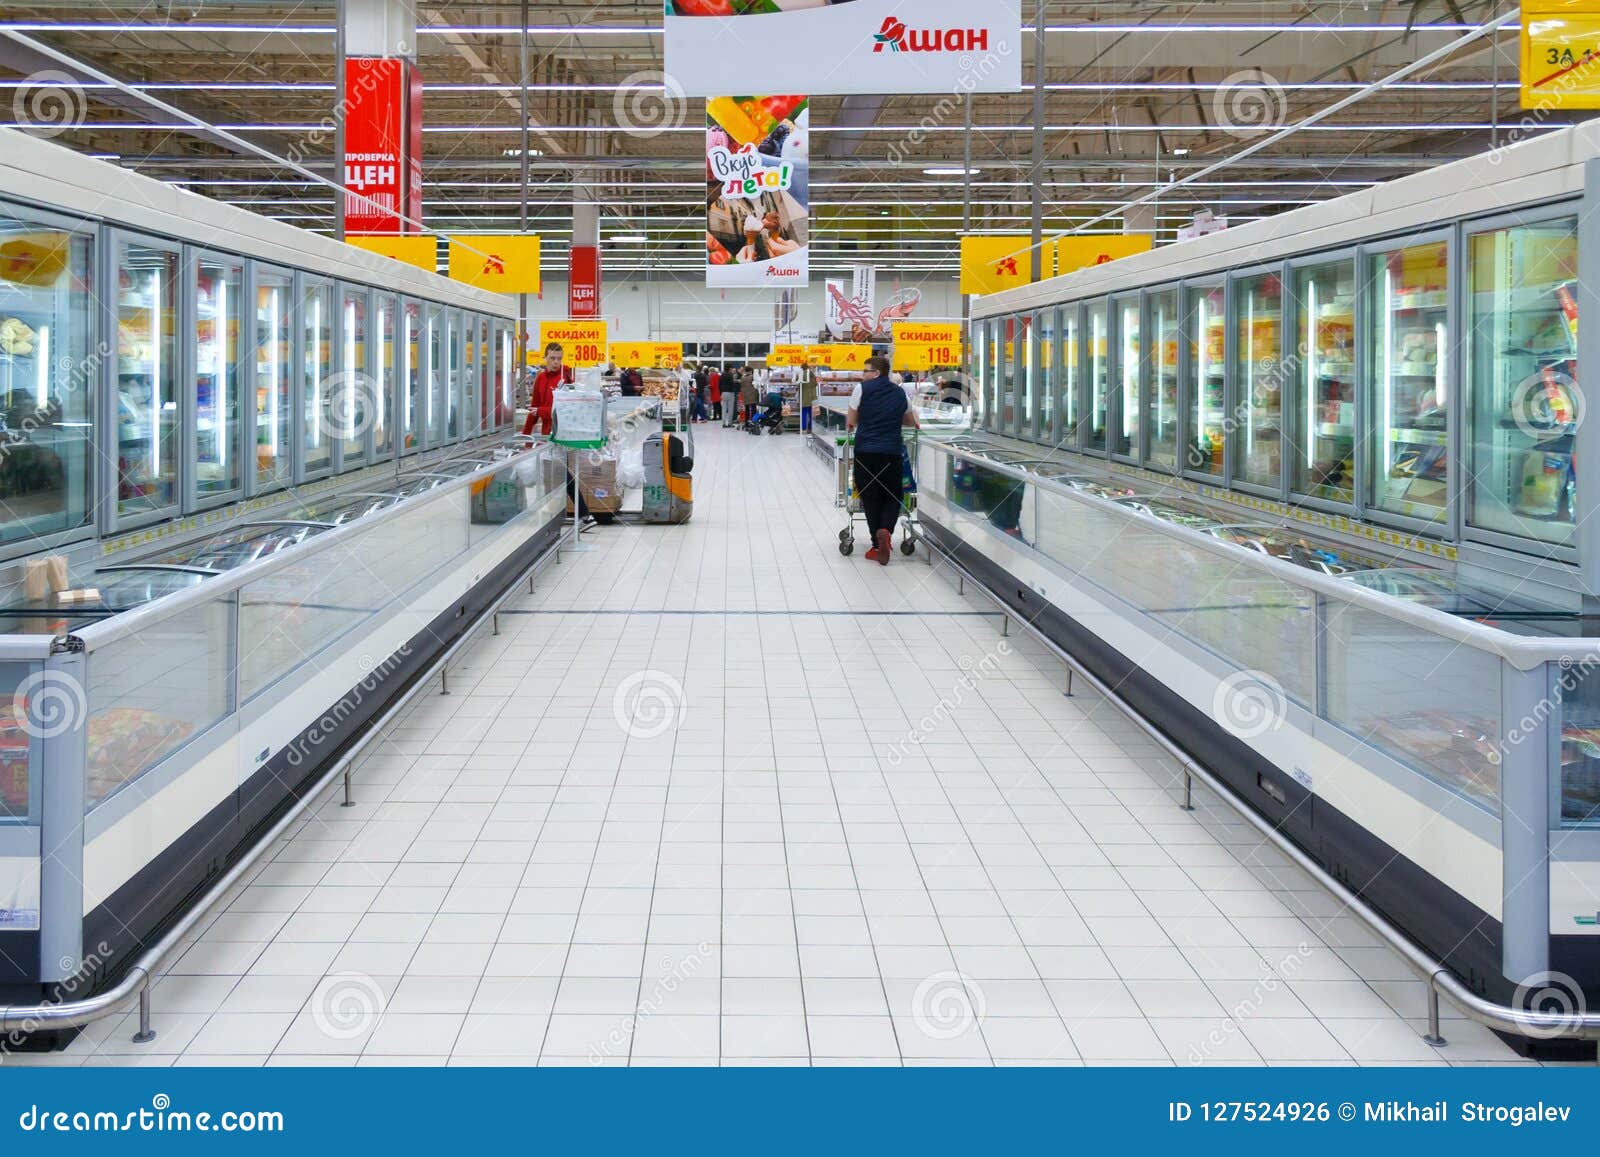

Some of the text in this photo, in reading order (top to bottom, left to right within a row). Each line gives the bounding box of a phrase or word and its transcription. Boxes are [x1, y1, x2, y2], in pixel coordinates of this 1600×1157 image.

[872, 16, 988, 53] Ашан
[344, 153, 395, 162] ПРОВЕРКА
[713, 150, 757, 180] Вкус
[344, 165, 395, 190] ЦЕН
[766, 265, 800, 277] Ашан
[572, 289, 594, 300] ЦЕН
[546, 330, 600, 340] СКИДКИ!
[899, 331, 953, 342] СКИДКИ!
[574, 344, 598, 362] 380
[927, 347, 950, 364] 119
